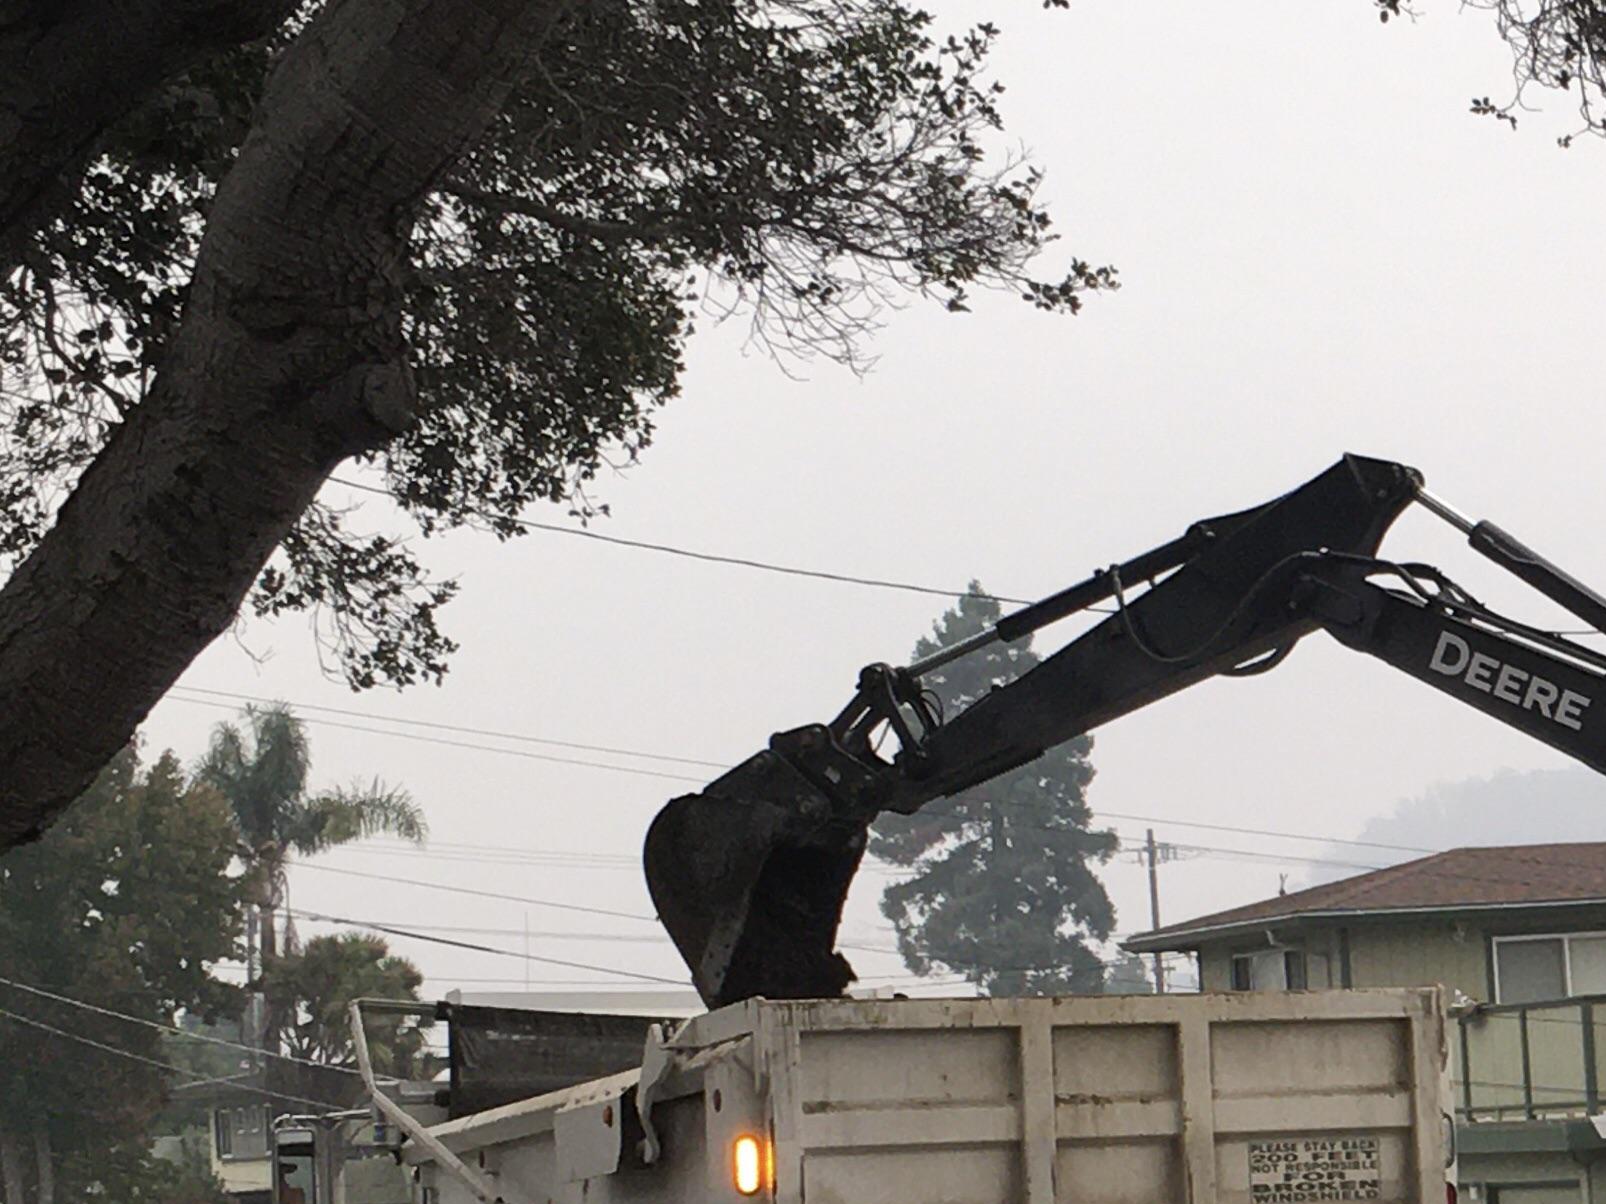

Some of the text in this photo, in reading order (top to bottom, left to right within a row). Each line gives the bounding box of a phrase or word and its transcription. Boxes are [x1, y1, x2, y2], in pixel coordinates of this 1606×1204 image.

[1428, 630, 1591, 731] DEERE
[1250, 1139, 1375, 1153] PLEASE STAY BACK
[1251, 1150, 1377, 1163] 200 FEET
[1251, 1160, 1377, 1173] NOT RESPONSIBLE
[1283, 1171, 1346, 1182] FOR
[1252, 1179, 1379, 1193] BROKEN
[1252, 1189, 1379, 1204] WINDSHIELD
